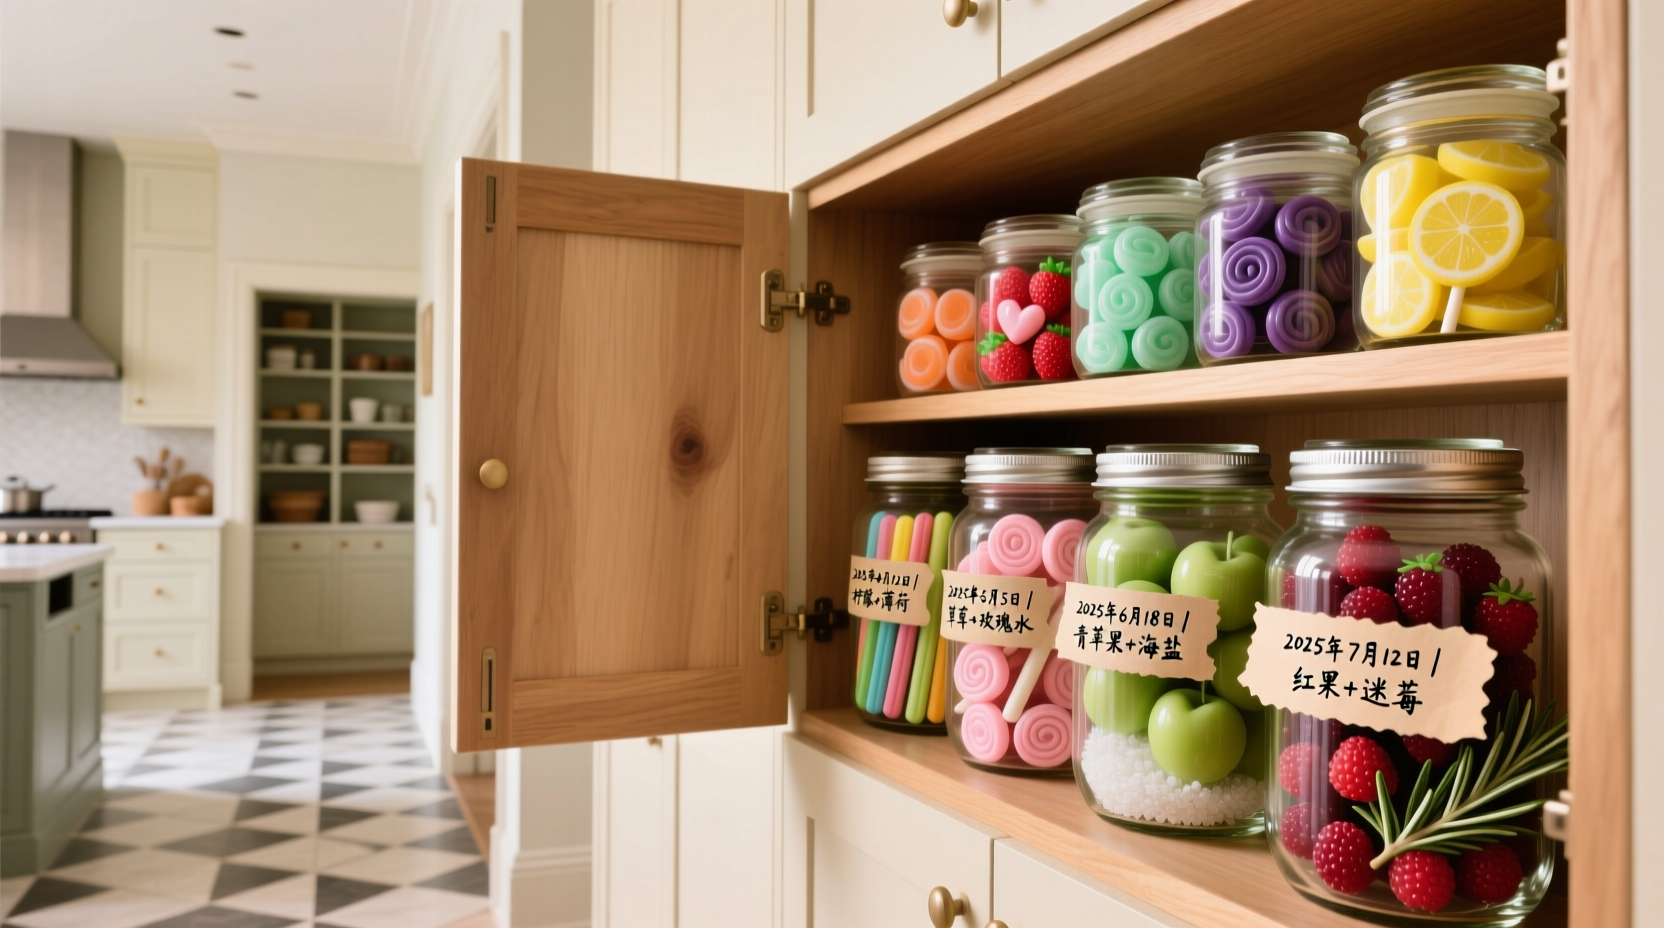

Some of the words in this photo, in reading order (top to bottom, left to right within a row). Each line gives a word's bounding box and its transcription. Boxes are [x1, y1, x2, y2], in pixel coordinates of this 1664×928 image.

[1076, 600, 1174, 628] 2025年6月18日
[1073, 624, 1184, 661] 青苹果+海盐
[1283, 633, 1420, 670] 2025年7月12日
